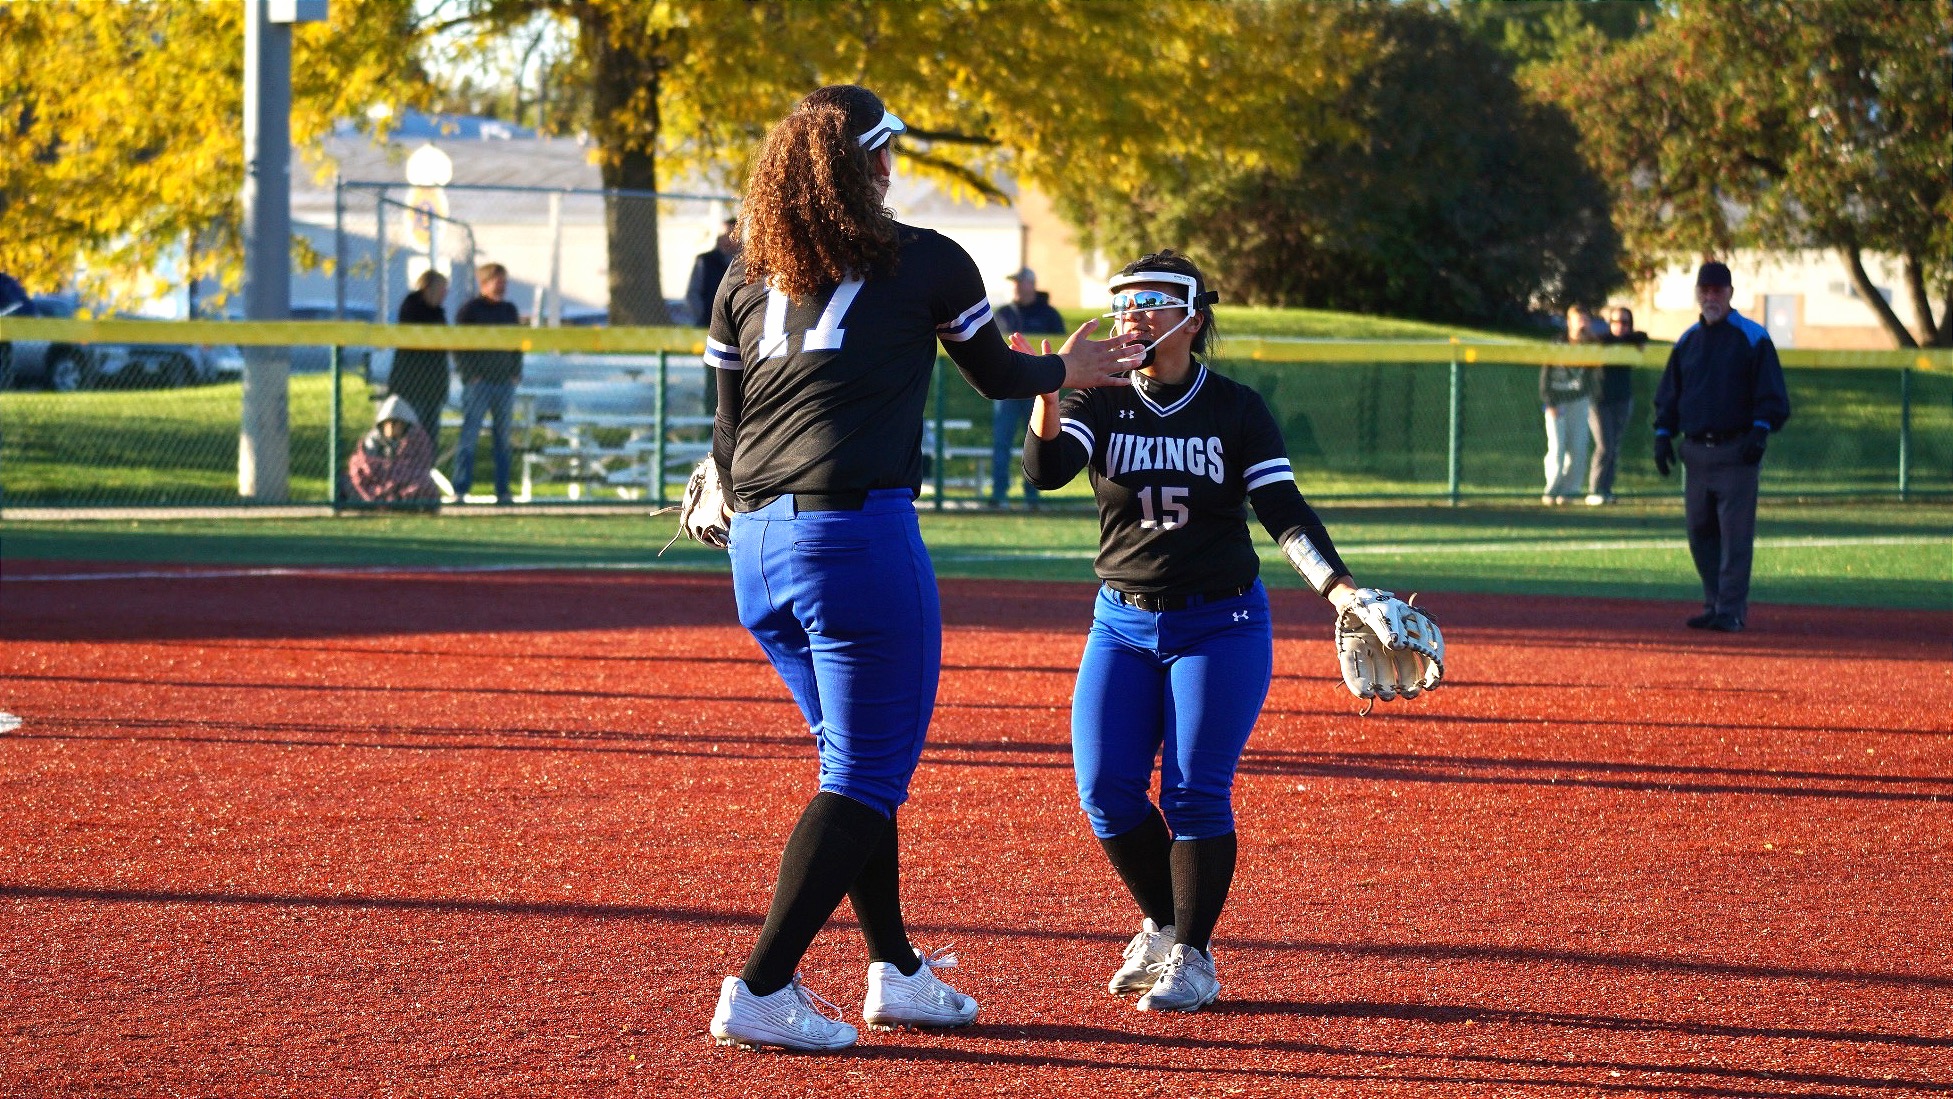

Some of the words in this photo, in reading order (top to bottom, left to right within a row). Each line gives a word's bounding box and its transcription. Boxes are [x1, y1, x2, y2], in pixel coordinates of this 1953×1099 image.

[757, 270, 866, 361] 17
[1105, 432, 1225, 484] VIKINGS
[1137, 486, 1189, 531] 15
